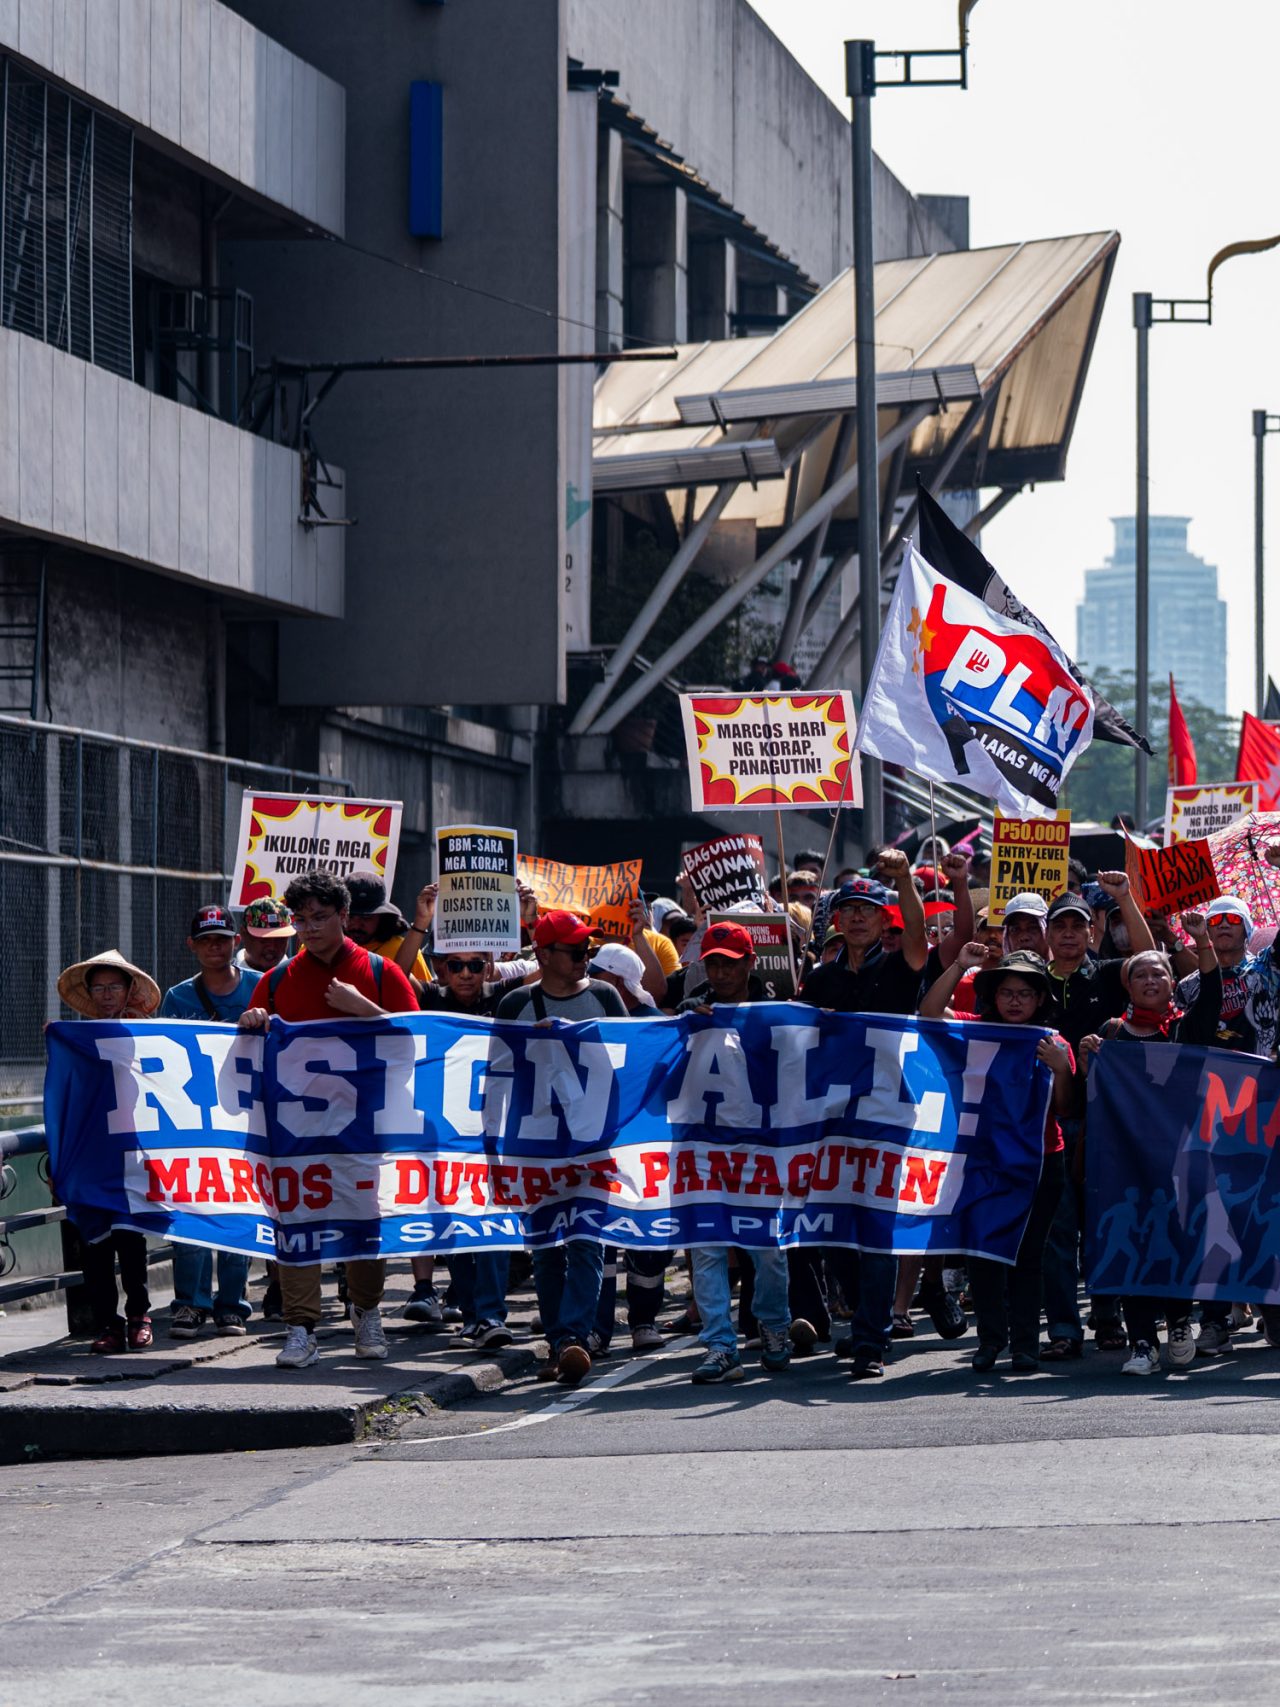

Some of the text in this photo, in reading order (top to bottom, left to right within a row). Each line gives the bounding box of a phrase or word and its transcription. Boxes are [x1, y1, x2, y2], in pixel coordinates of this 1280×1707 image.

[717, 721, 827, 739] MARCOS HARI
[733, 739, 815, 757] NG KORAP,
[980, 733, 1028, 769] LAKAS
[1027, 761, 1050, 782] NG
[729, 758, 822, 776] PANAGUTIN!
[1183, 803, 1242, 816] MARCOS HARI
[1190, 817, 1202, 828] NG
[999, 821, 1066, 844] P50,000
[264, 834, 371, 859] IKULONG MGA
[448, 837, 504, 854] BBM-SARA
[998, 845, 1065, 861] ENTRY-LEVEL
[444, 856, 508, 872] MGA KORAP!
[683, 838, 746, 872] BAGUHIN
[998, 860, 1061, 885] PAY FOR
[450, 876, 502, 892] NATIONAL
[701, 876, 752, 904] SUMALI
[443, 897, 511, 913] DISASTER SA
[444, 919, 509, 933] TAUMBAYAN
[753, 935, 780, 945] PABAYA
[754, 955, 789, 971] PTION
[95, 1025, 1001, 1142] RESIGN ALL!
[143, 1157, 333, 1213] MARCOS
[394, 1158, 622, 1207] DUTERTE
[639, 1144, 947, 1205] PANAGUTIN
[255, 1223, 345, 1253] BMP
[400, 1207, 681, 1243] SANLAKAS
